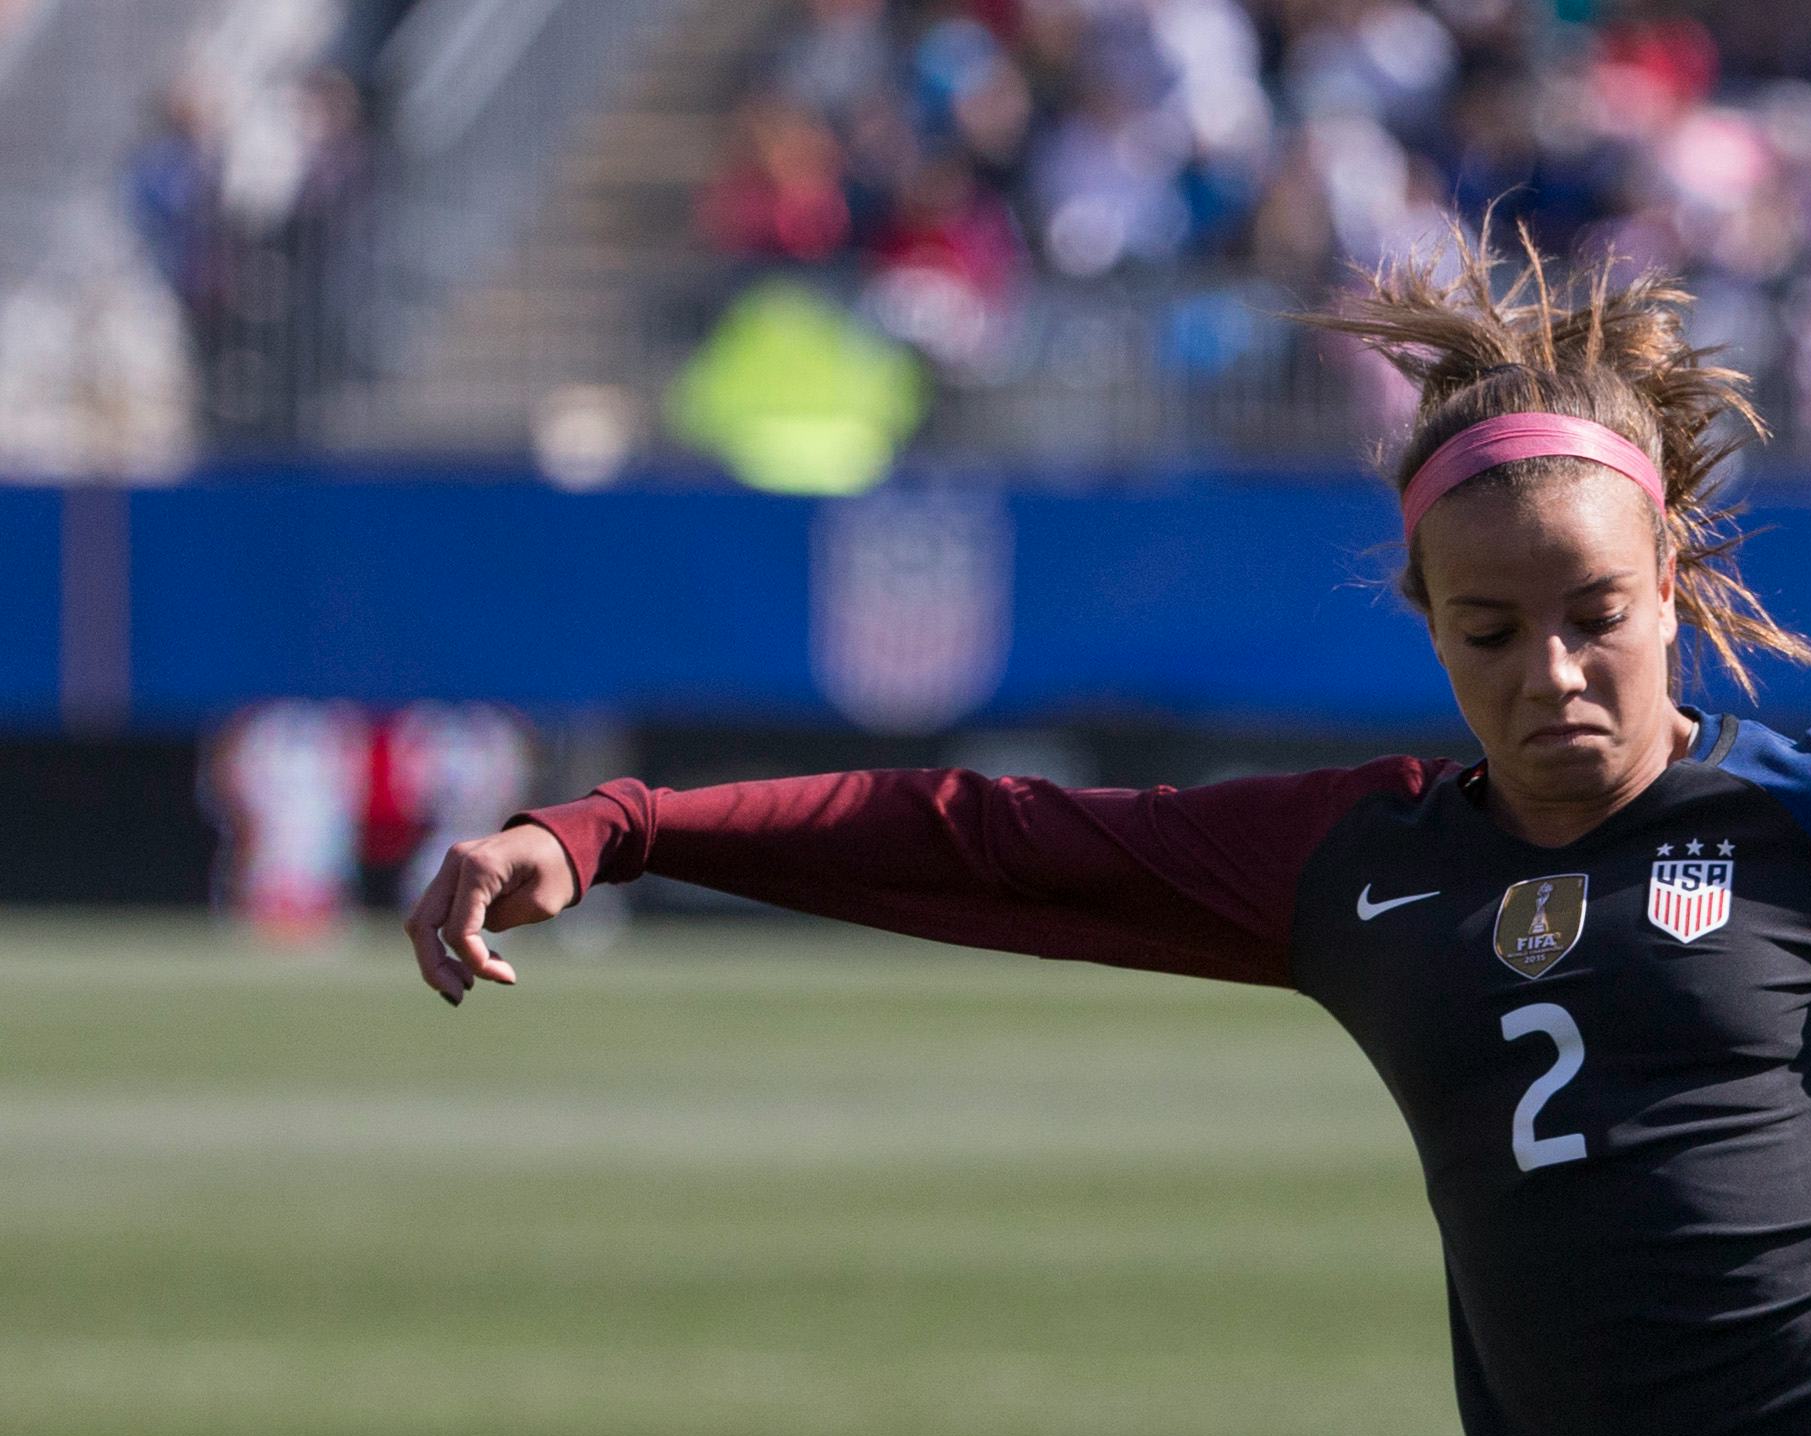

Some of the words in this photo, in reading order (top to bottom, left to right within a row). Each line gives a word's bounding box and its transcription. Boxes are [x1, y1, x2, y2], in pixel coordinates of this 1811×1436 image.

[1657, 864, 1727, 892] USA
[1516, 934, 1557, 952] FIFA
[1524, 954, 1547, 964] 2015
[1500, 1002, 1587, 1172] 2
